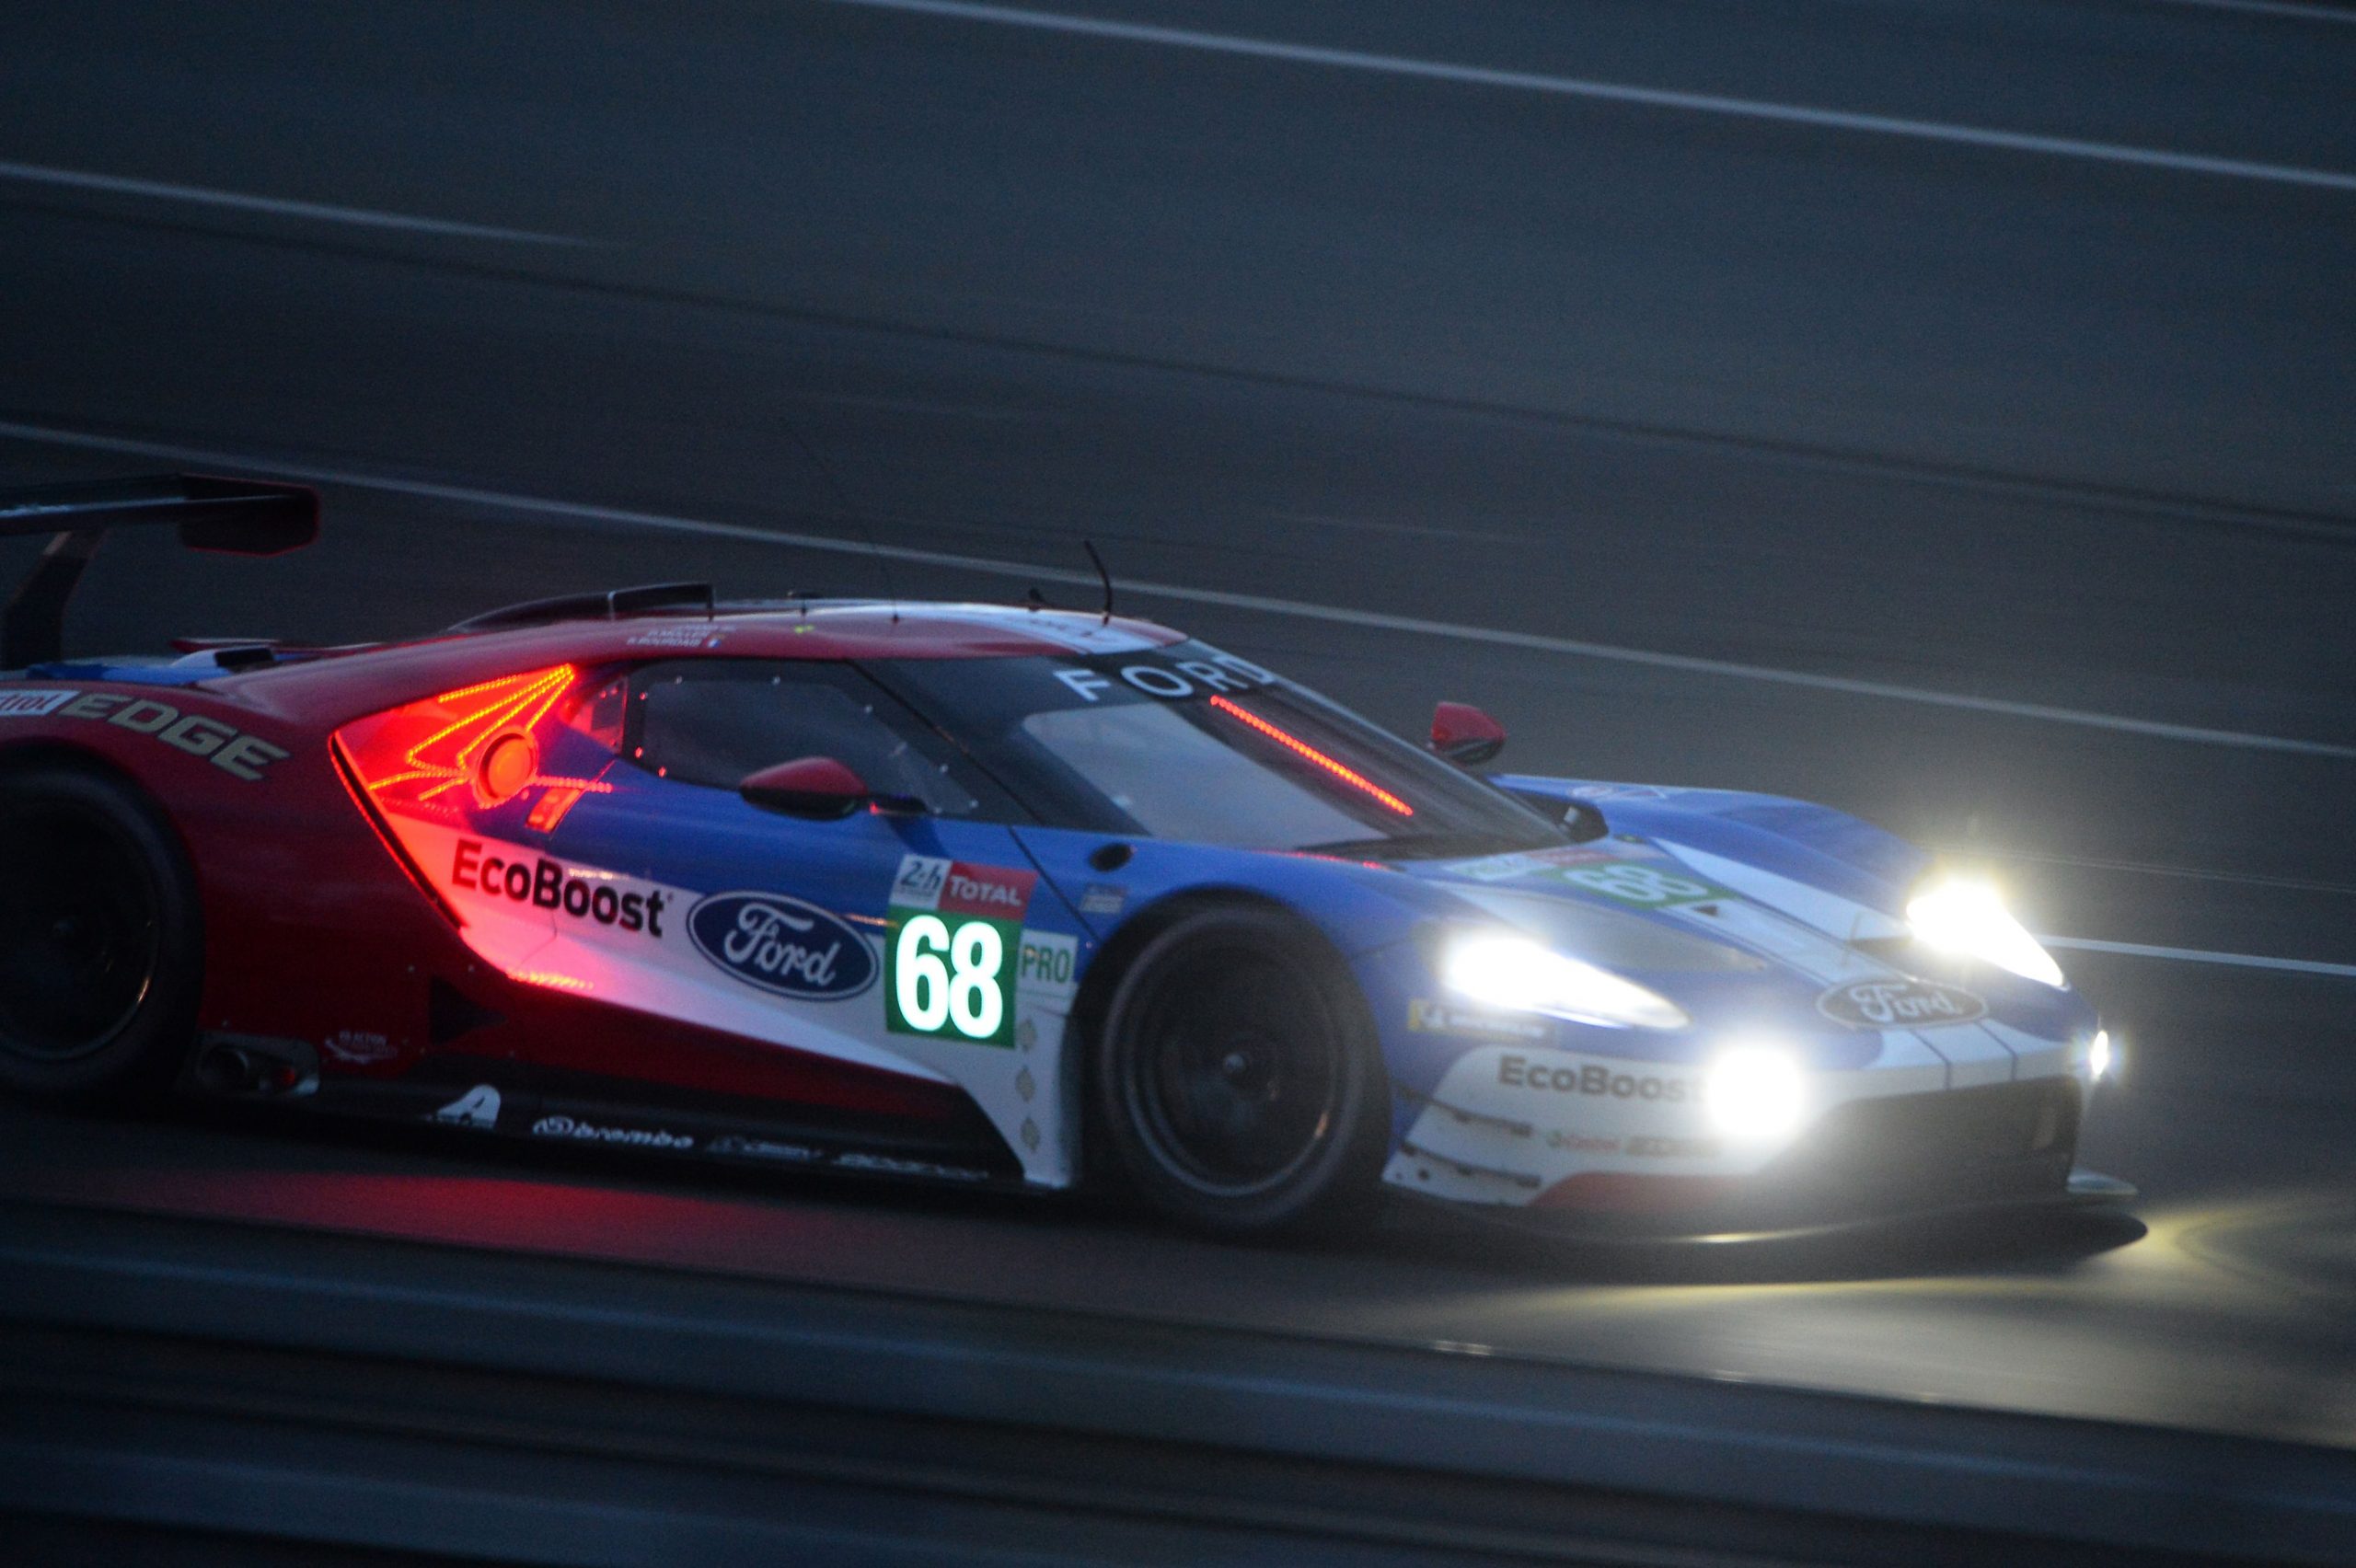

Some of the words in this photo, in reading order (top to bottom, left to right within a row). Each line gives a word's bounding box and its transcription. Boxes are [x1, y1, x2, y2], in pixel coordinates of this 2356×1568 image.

[1054, 655, 1276, 702] FORD
[56, 693, 291, 781] EDGE
[451, 838, 664, 938] EcoBoost
[948, 875, 1022, 907] TOTAL
[723, 903, 841, 986] Ford
[1021, 944, 1071, 984] PRO
[895, 915, 1003, 1039] 68
[1848, 984, 1964, 1023] Ford
[1498, 1054, 1709, 1103] EcoBoos
